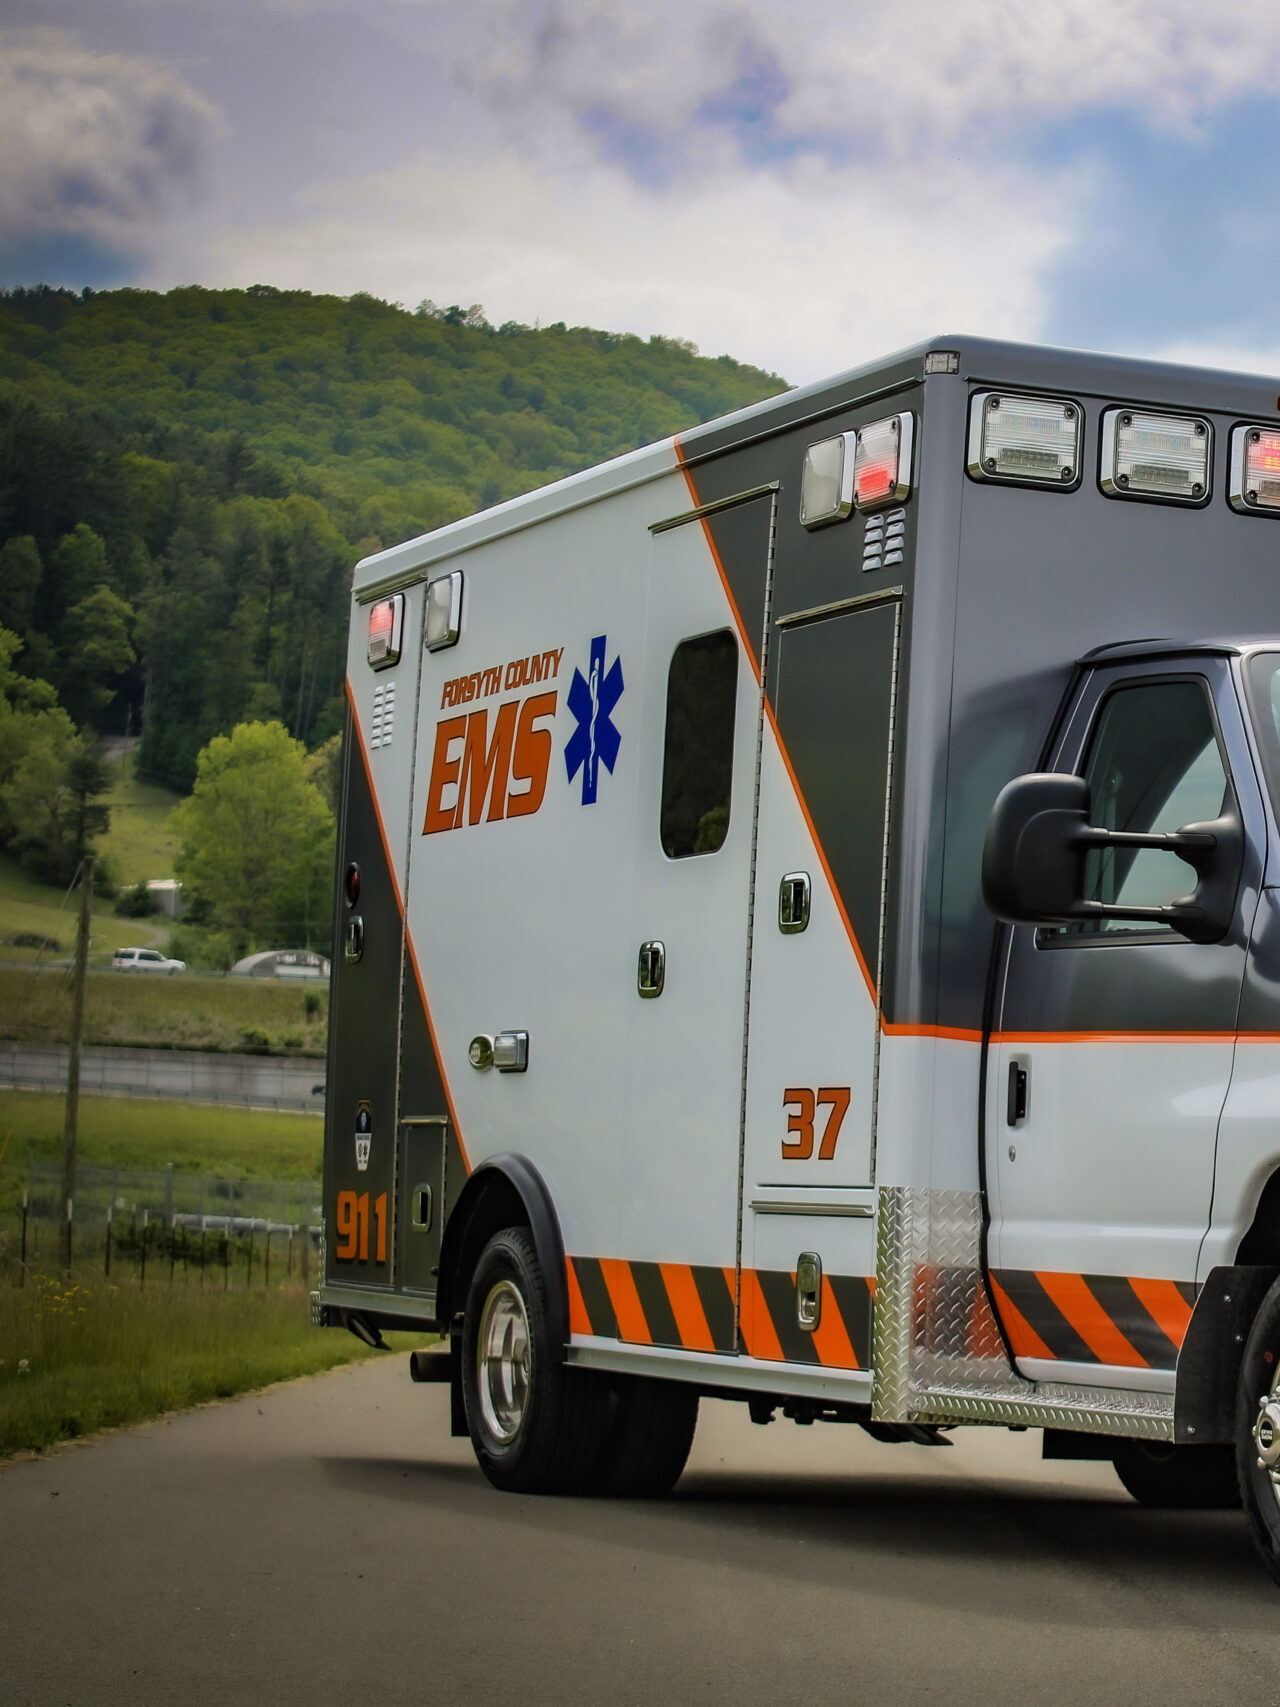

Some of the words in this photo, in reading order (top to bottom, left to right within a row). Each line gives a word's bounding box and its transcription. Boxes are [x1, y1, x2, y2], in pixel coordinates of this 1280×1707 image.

[440, 665, 504, 710] FORSYTH
[504, 647, 565, 691] COUNTY
[422, 690, 558, 836] EMS
[781, 1087, 851, 1160] 37
[336, 1190, 387, 1263] 911
